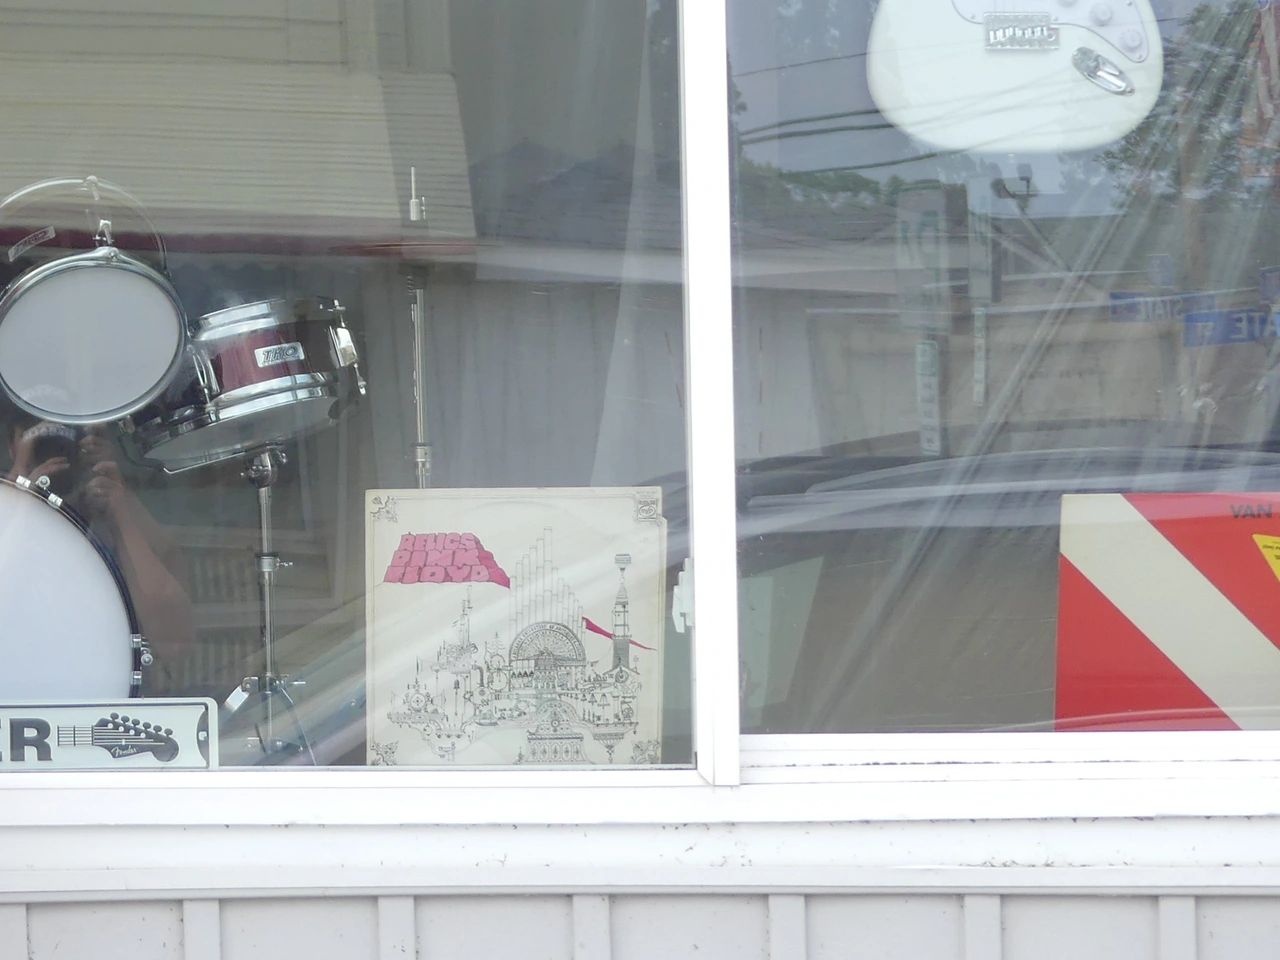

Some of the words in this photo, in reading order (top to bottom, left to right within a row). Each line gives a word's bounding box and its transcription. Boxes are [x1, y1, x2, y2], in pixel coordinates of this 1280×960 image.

[263, 345, 298, 365] TKO
[1230, 504, 1273, 519] VAN
[390, 548, 482, 567] PINK
[383, 565, 490, 584] FLOYD
